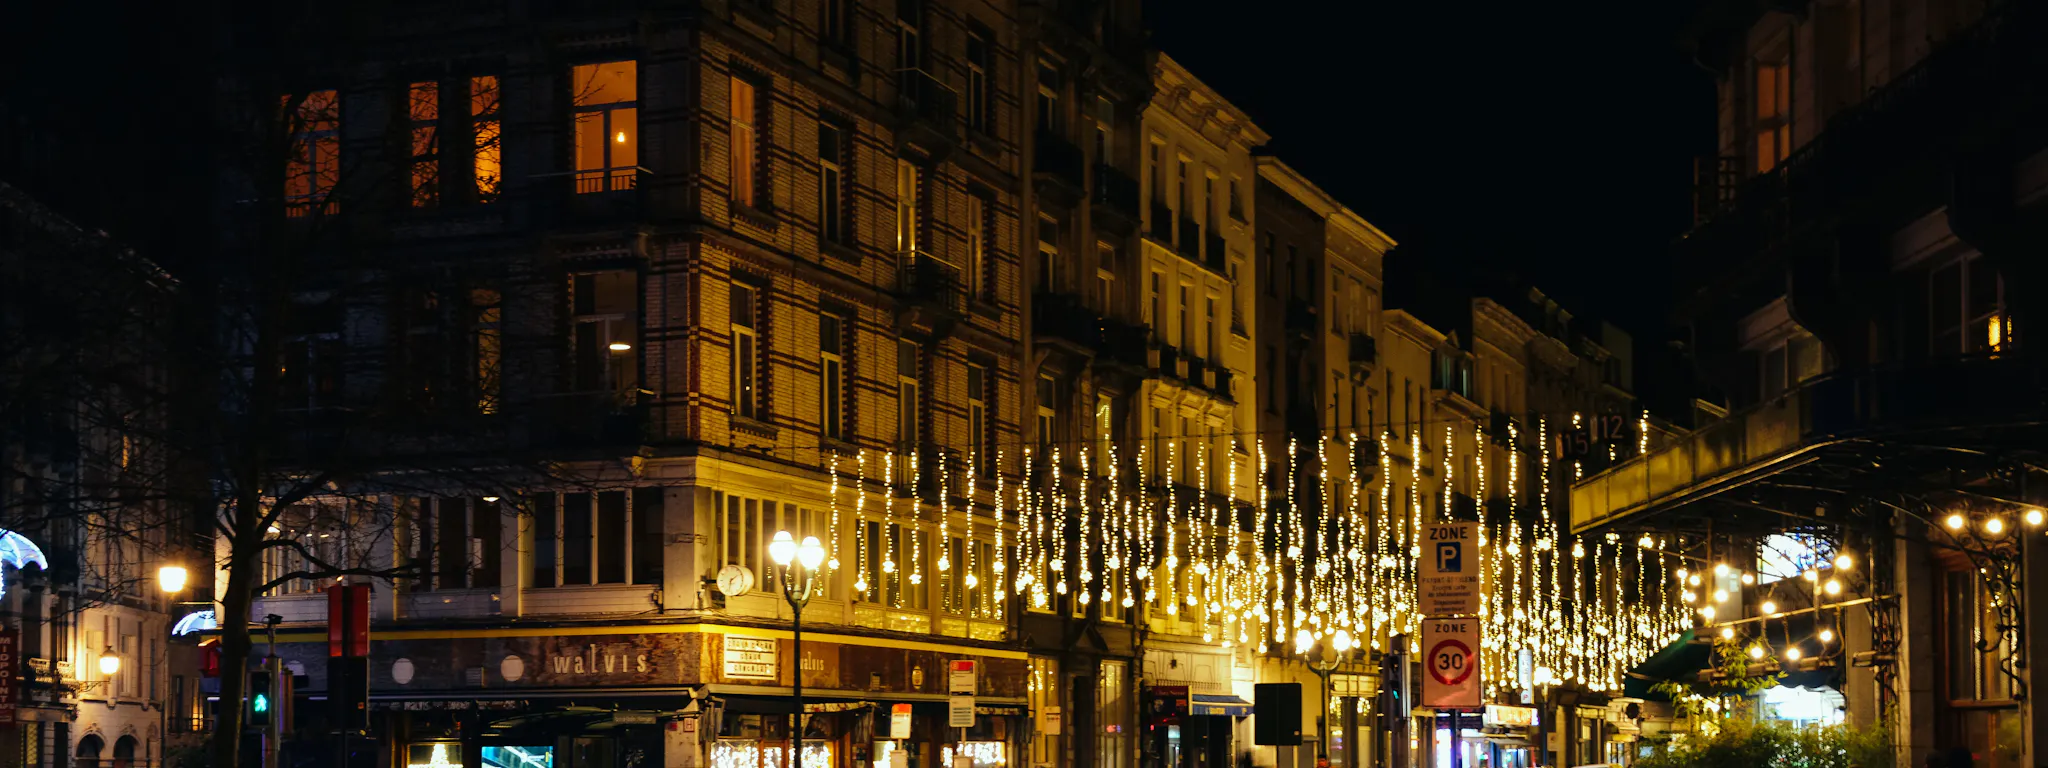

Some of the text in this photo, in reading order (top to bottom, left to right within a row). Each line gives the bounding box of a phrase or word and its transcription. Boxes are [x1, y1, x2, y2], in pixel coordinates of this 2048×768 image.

[1602, 415, 1624, 440] 12
[1565, 432, 1589, 455] 15
[1429, 527, 1468, 541] ZONE
[1435, 624, 1467, 633] ZONE
[553, 643, 647, 674] walvis
[1439, 653, 1463, 670] 30
